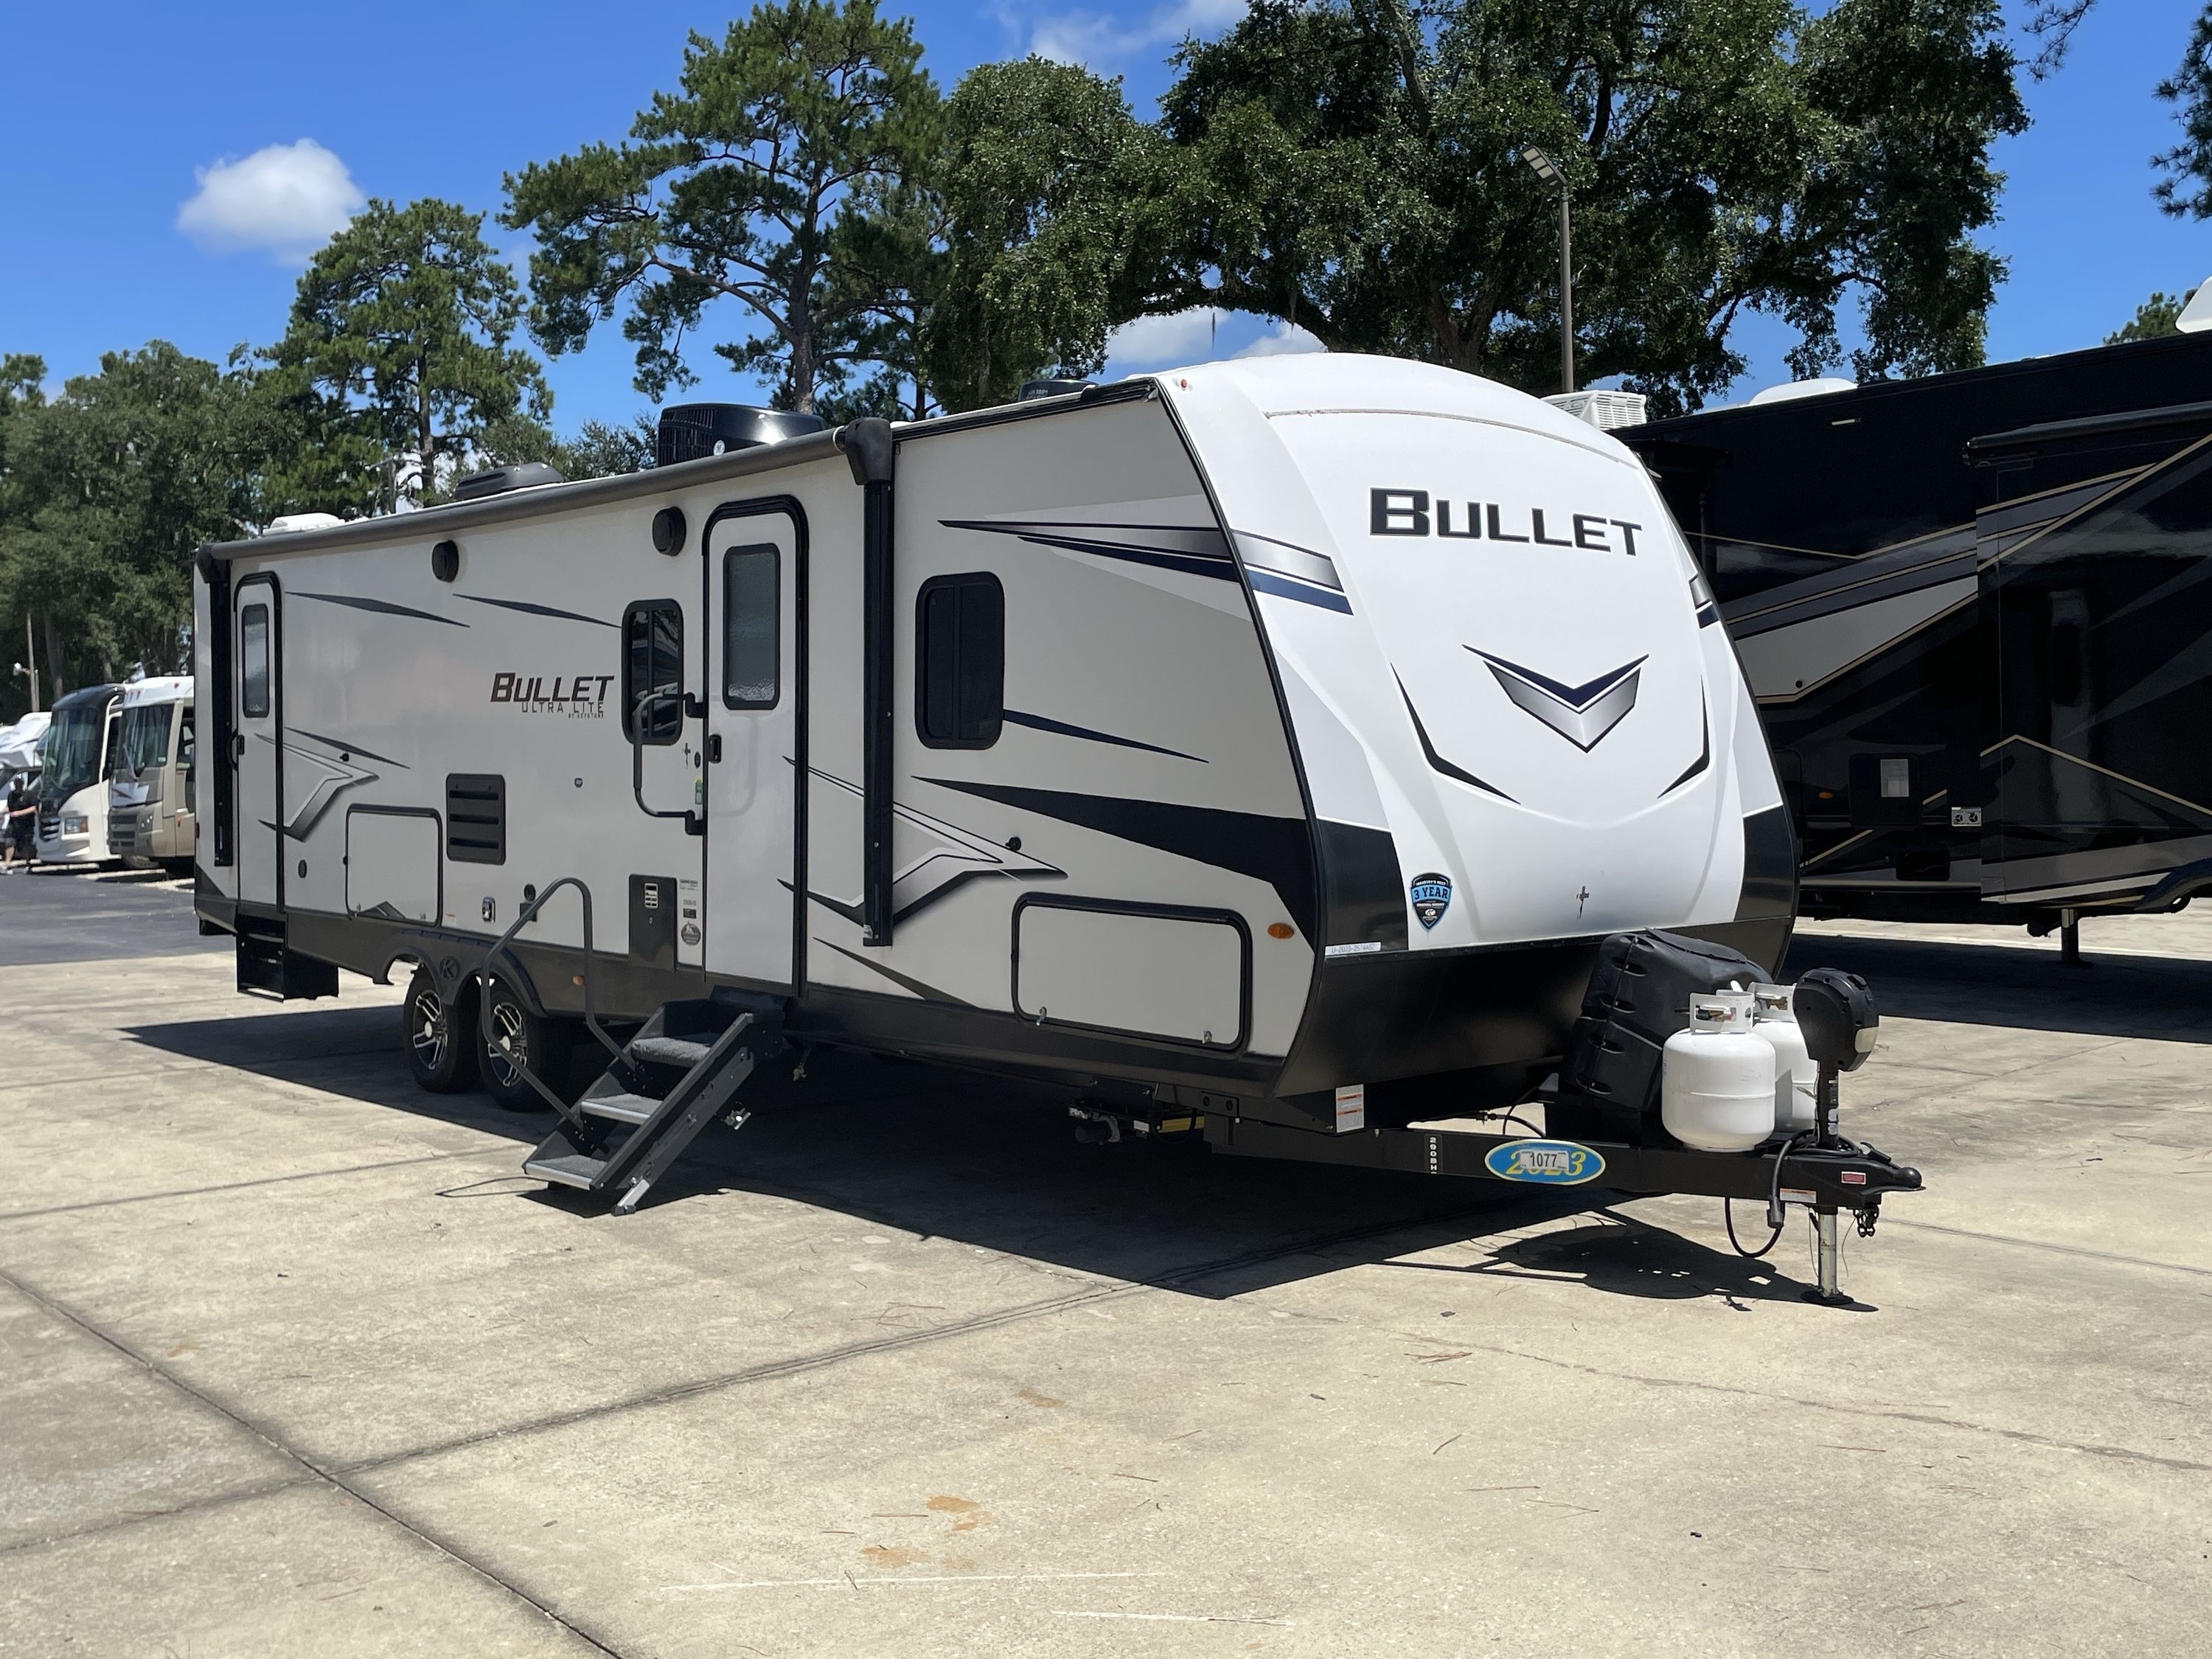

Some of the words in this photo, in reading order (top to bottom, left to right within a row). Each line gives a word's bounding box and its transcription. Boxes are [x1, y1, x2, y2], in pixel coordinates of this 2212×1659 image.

[1369, 487, 1642, 557] BULLET
[490, 672, 615, 702] BULLET
[521, 701, 564, 713] ULTRA
[573, 701, 604, 713] LITE
[1413, 889, 1420, 900] 3
[1422, 886, 1449, 899] YEAR
[1529, 1152, 1558, 1167] 1077
